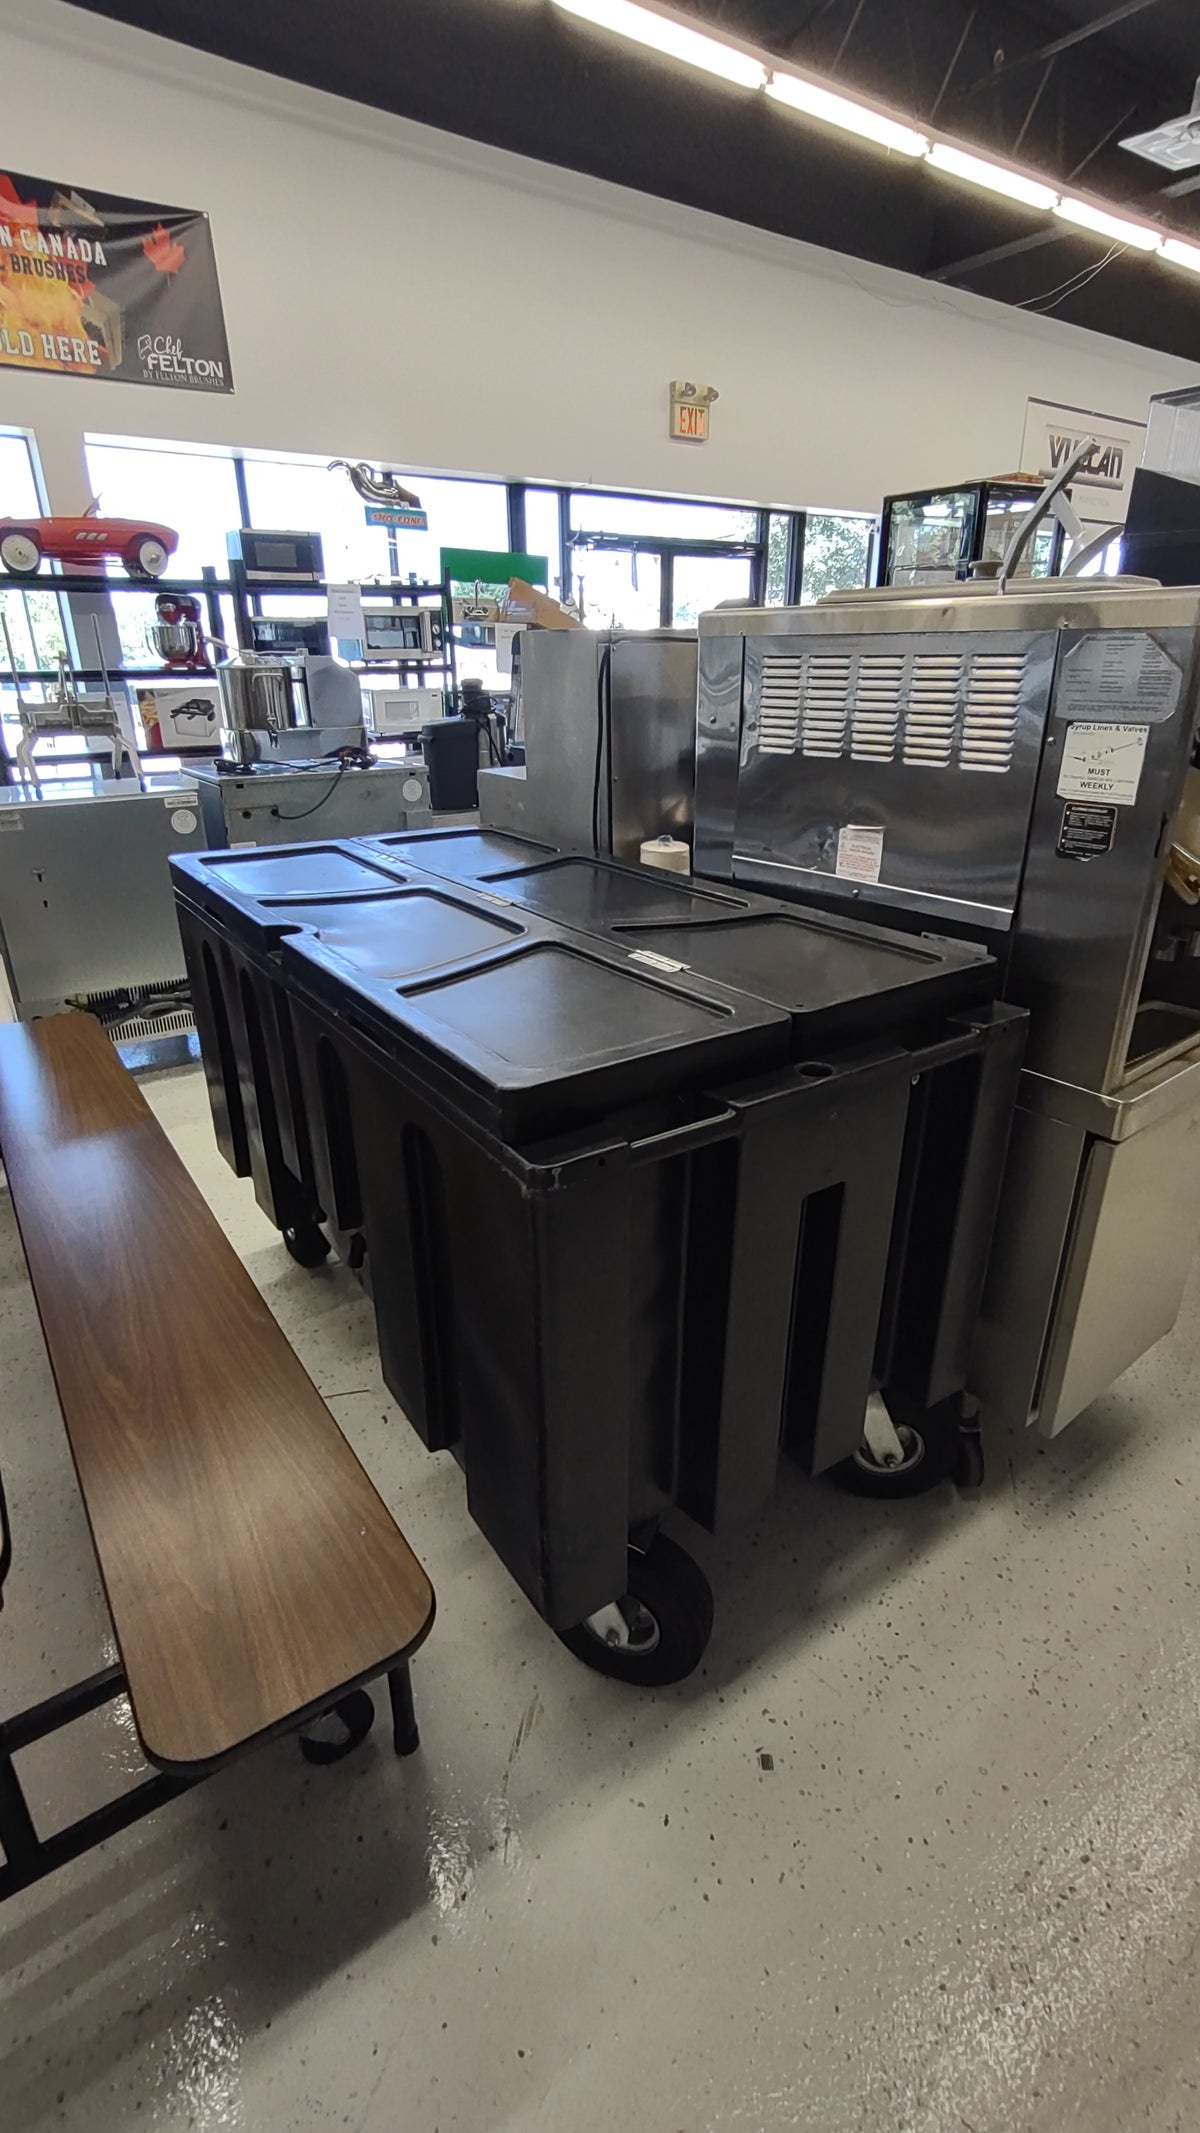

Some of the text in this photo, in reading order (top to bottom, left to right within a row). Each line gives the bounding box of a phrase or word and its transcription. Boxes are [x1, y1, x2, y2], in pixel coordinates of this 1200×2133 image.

[20, 229, 107, 266] CANADA
[10, 253, 86, 284] BRUSHES
[0, 328, 102, 365] LD HERE
[154, 335, 184, 361] Chef
[143, 369, 155, 379] BY
[189, 375, 225, 387] BRUSHES
[147, 353, 224, 378] FELTON
[680, 406, 705, 436] EXIT
[1049, 434, 1124, 479] VUCAN
[1080, 781, 1114, 791] WEEKLY
[1087, 768, 1111, 776] MUST
